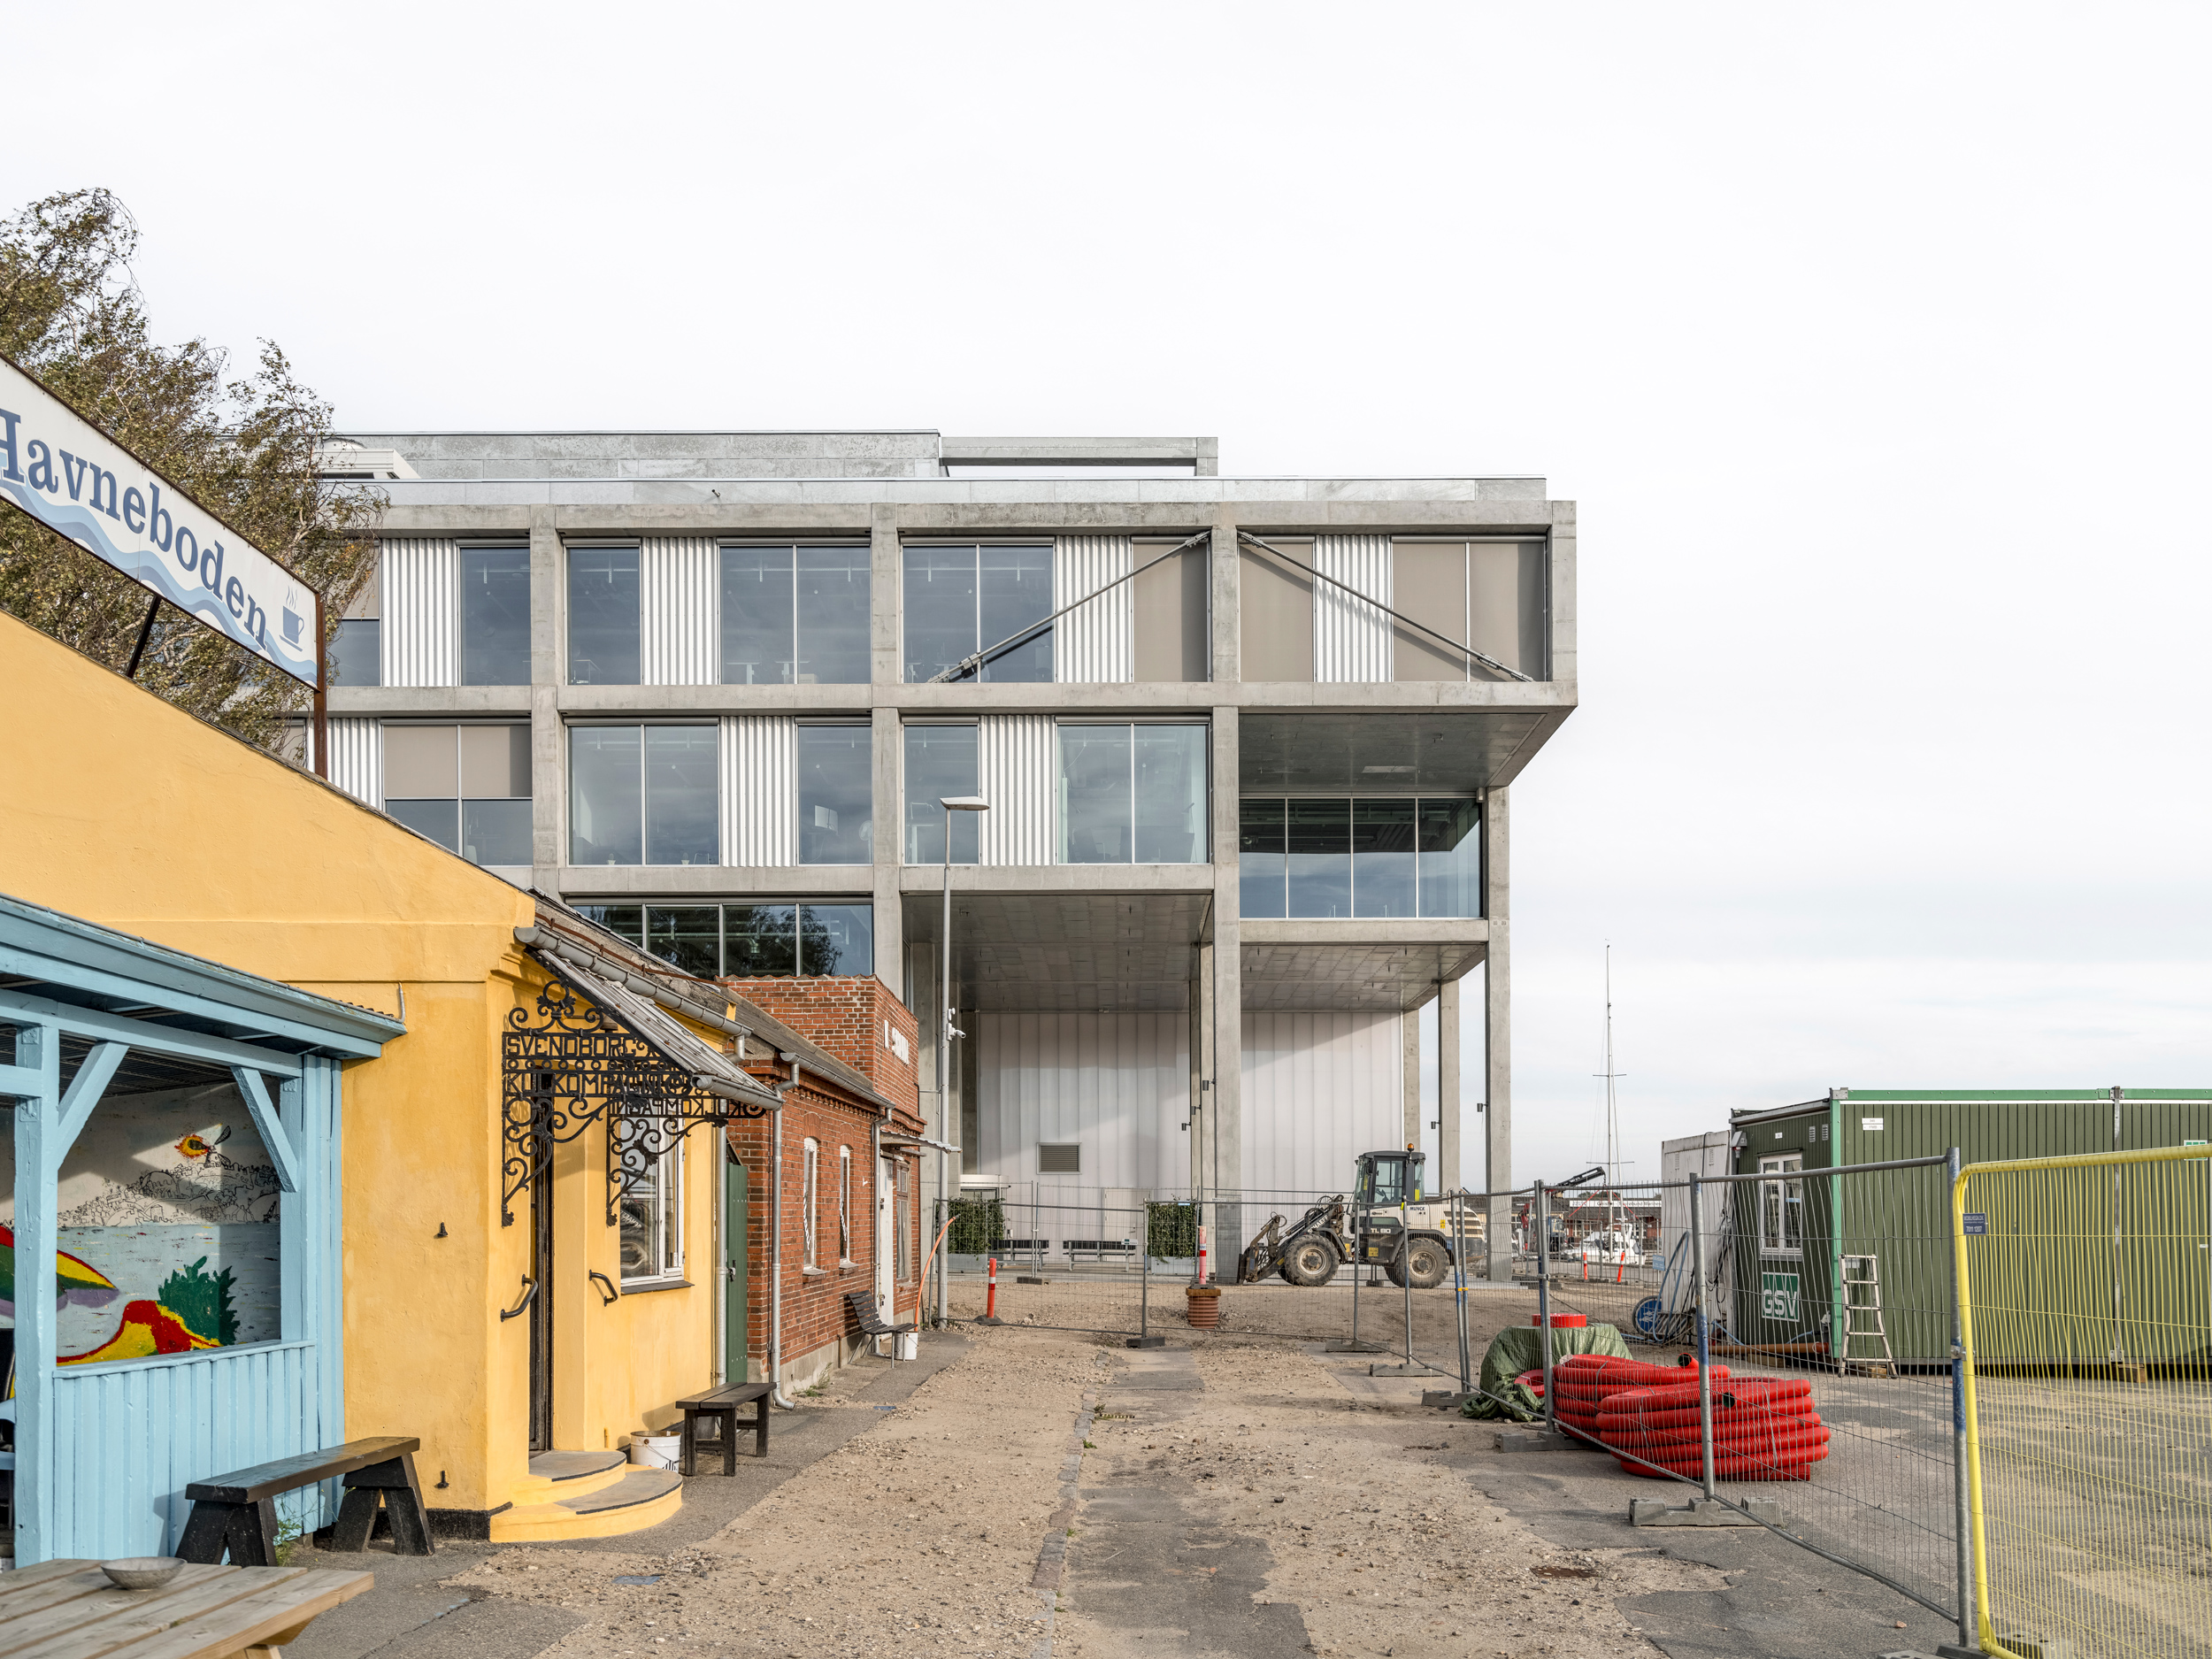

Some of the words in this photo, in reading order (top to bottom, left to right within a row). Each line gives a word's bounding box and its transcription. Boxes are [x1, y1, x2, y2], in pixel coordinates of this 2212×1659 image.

[0, 408, 267, 649] Havneboden
[507, 1036, 637, 1056] SVENDBORG
[1763, 1288, 1797, 1317] GSV
